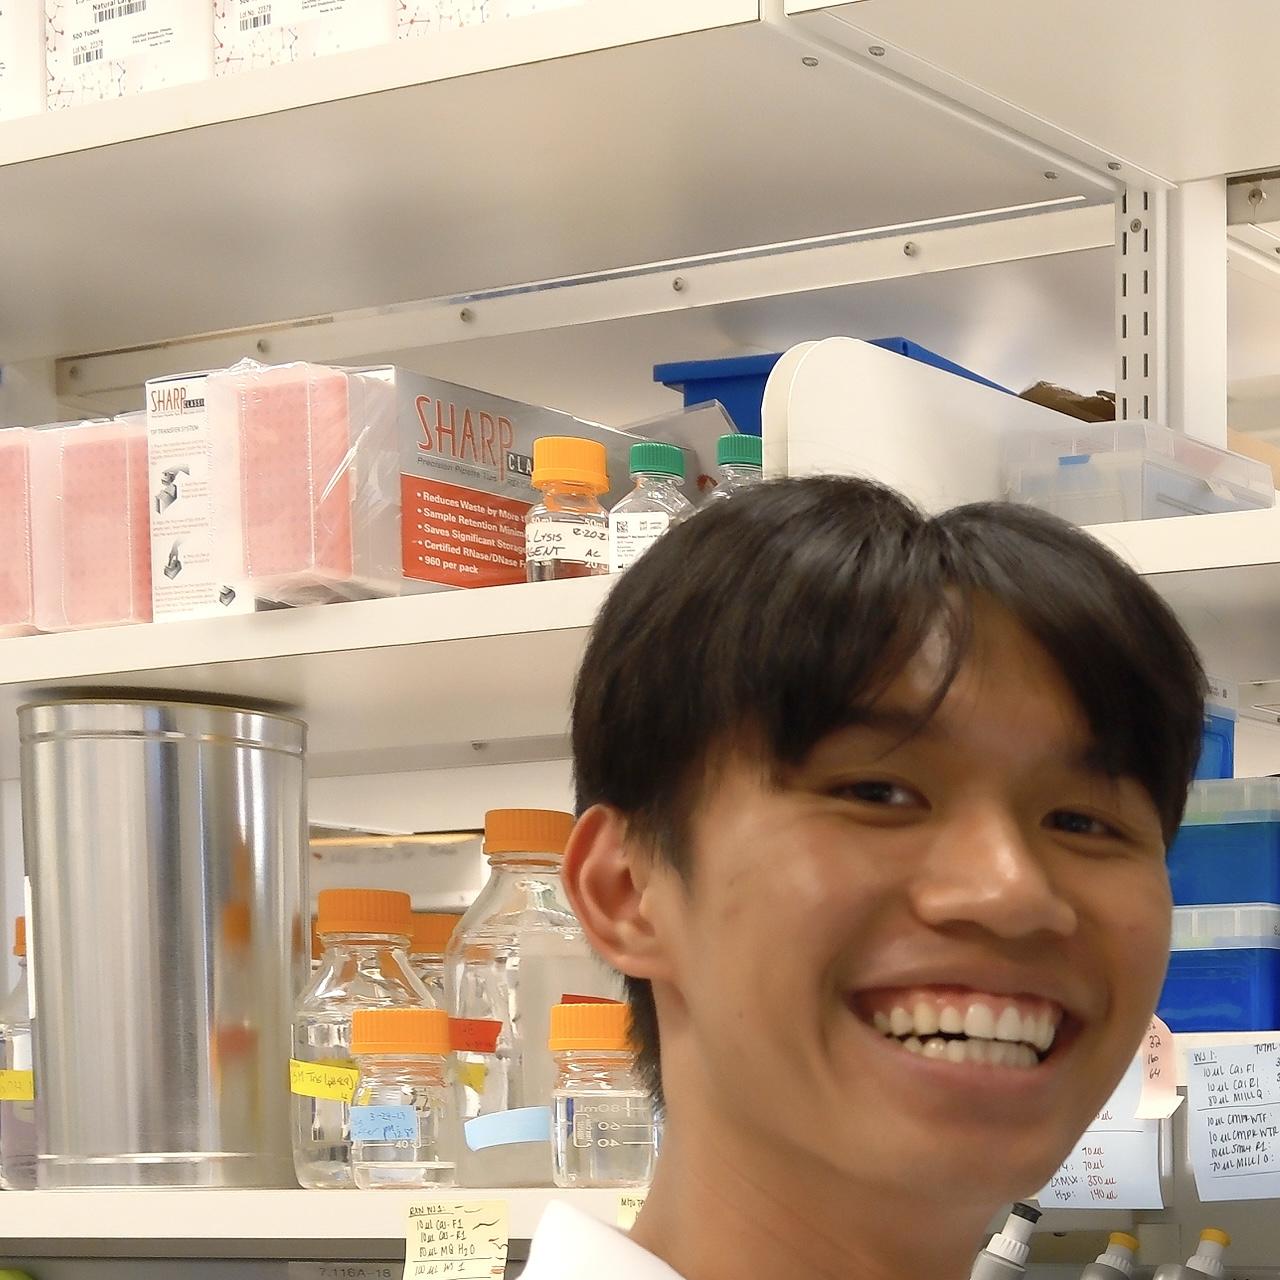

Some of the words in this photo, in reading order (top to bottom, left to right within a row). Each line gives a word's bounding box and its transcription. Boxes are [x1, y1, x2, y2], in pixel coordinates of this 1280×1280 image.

[414, 394, 514, 482] SHARP
[423, 492, 459, 509] Reduces
[460, 499, 485, 515] Waste
[487, 504, 497, 518] by
[498, 507, 521, 523] More
[423, 507, 457, 524] Sample
[459, 514, 498, 532] Retention
[424, 524, 451, 539] Saves
[452, 528, 496, 547] Significant
[424, 540, 461, 555] Certified
[462, 545, 517, 567] RNase/DNase
[424, 556, 441, 568] 960
[442, 558, 456, 572] per
[458, 562, 479, 575] pack
